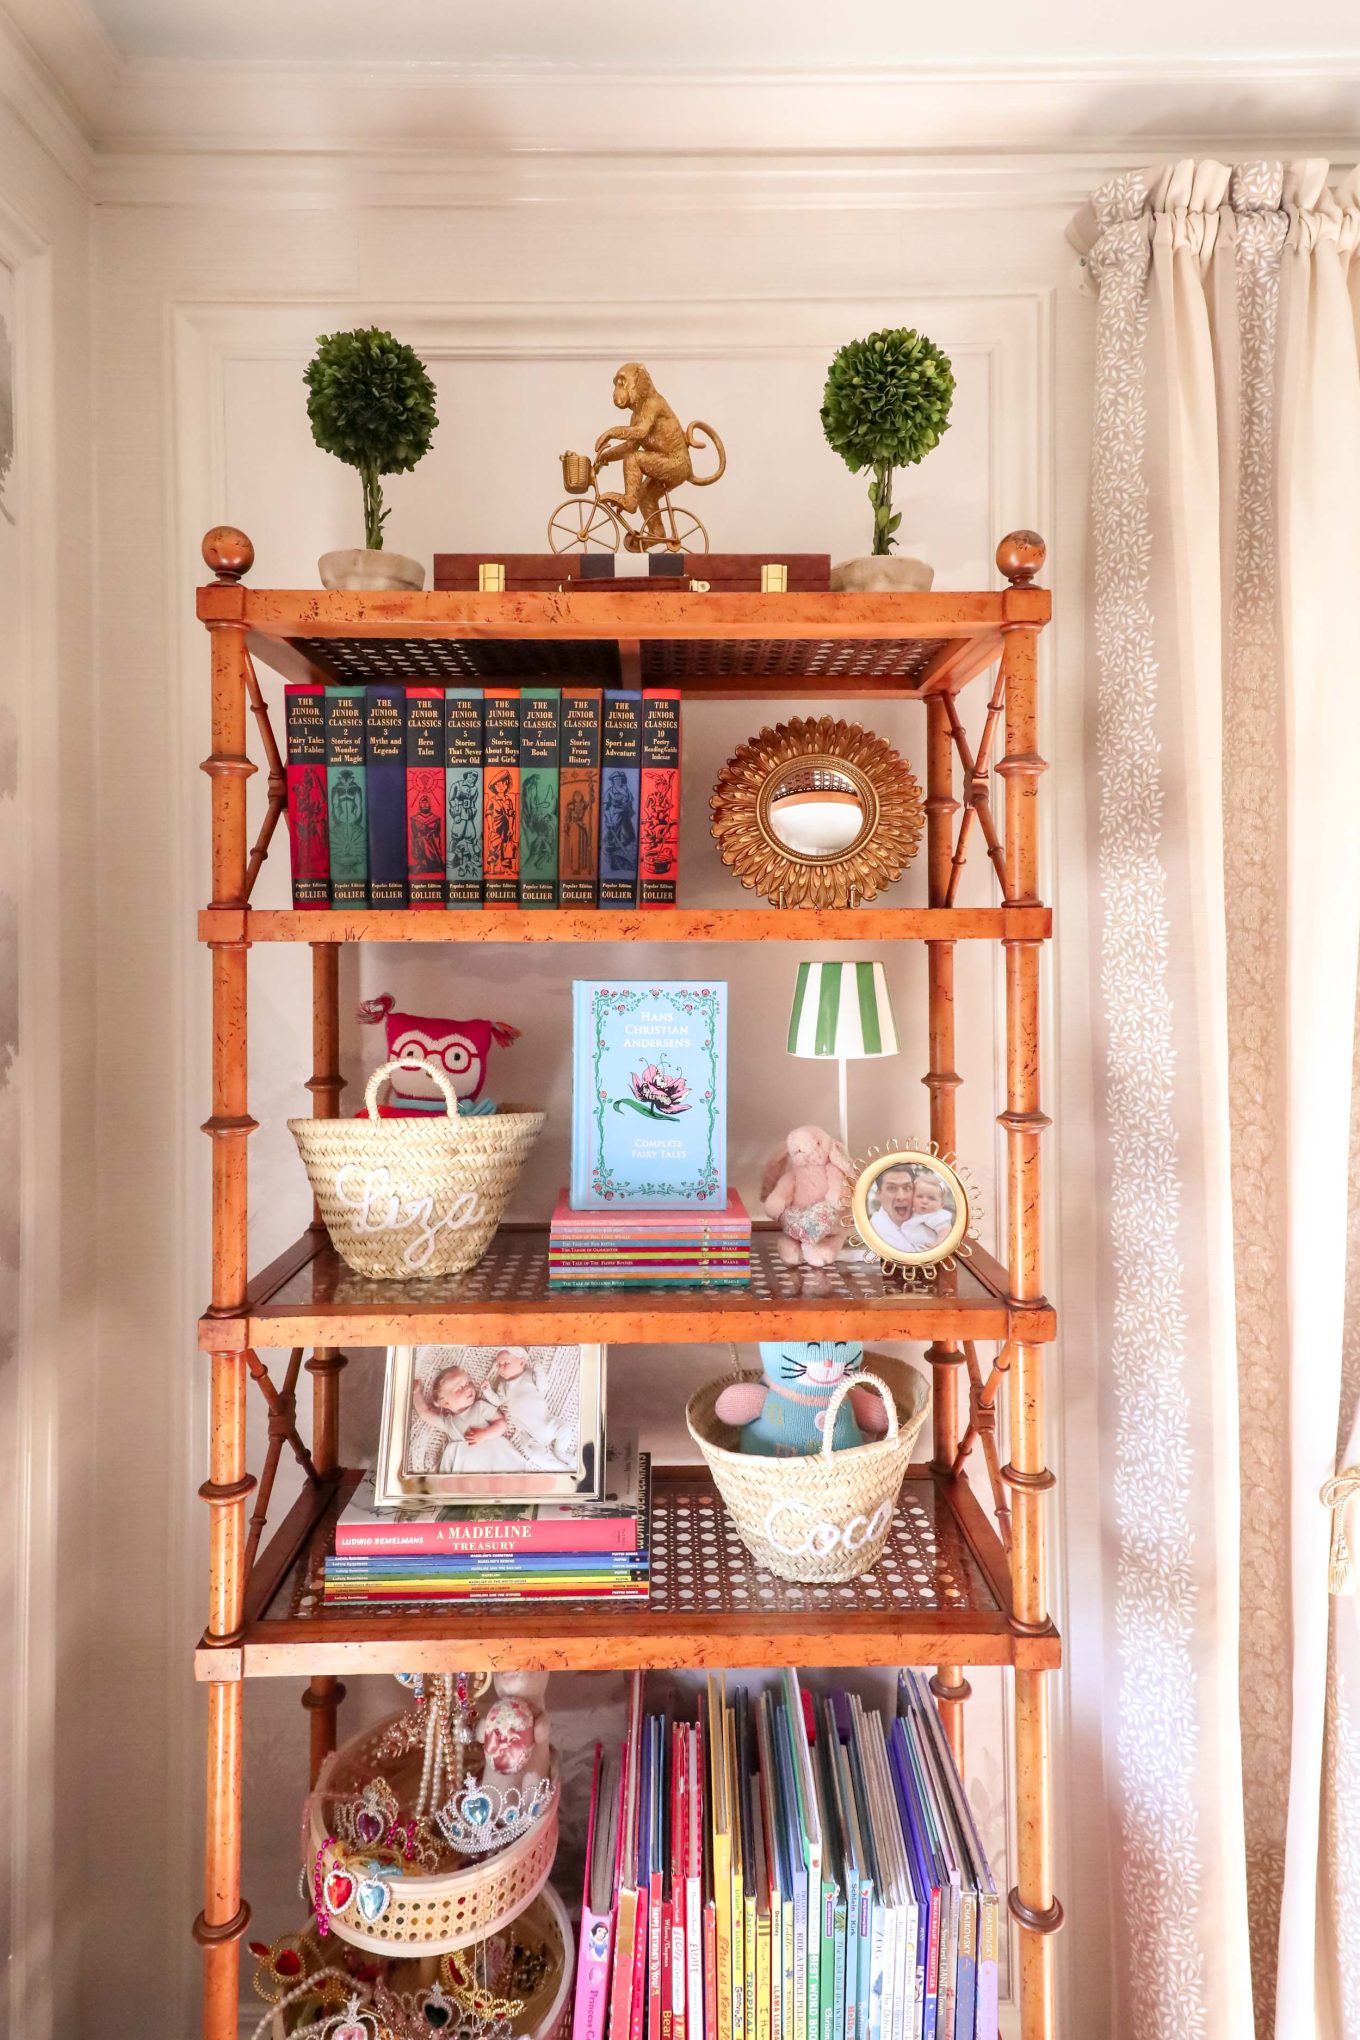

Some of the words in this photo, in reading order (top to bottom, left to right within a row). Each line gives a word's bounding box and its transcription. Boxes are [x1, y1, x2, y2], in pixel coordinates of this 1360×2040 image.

[289, 737, 305, 745] Fairy
[370, 737, 388, 745] Myths
[606, 740, 622, 748] Sport
[505, 748, 519, 756] Boys
[344, 755, 362, 764] Magic
[569, 757, 590, 765] History
[296, 890, 327, 899] COLLIER
[625, 1024, 688, 1035] CHRISTIAN
[436, 1530, 444, 1540] A
[450, 1525, 532, 1539] MADELINE
[375, 1537, 424, 1545] BEMELMANS
[452, 1541, 515, 1551] TREASURY
[652, 1907, 660, 1926] HAPPY
[651, 1928, 660, 1960] BIRTHDAY
[809, 1956, 818, 1979] BEST
[809, 1983, 818, 2015] WORD
[586, 1990, 599, 2028] Princess
[663, 2010, 672, 2037] Bear
